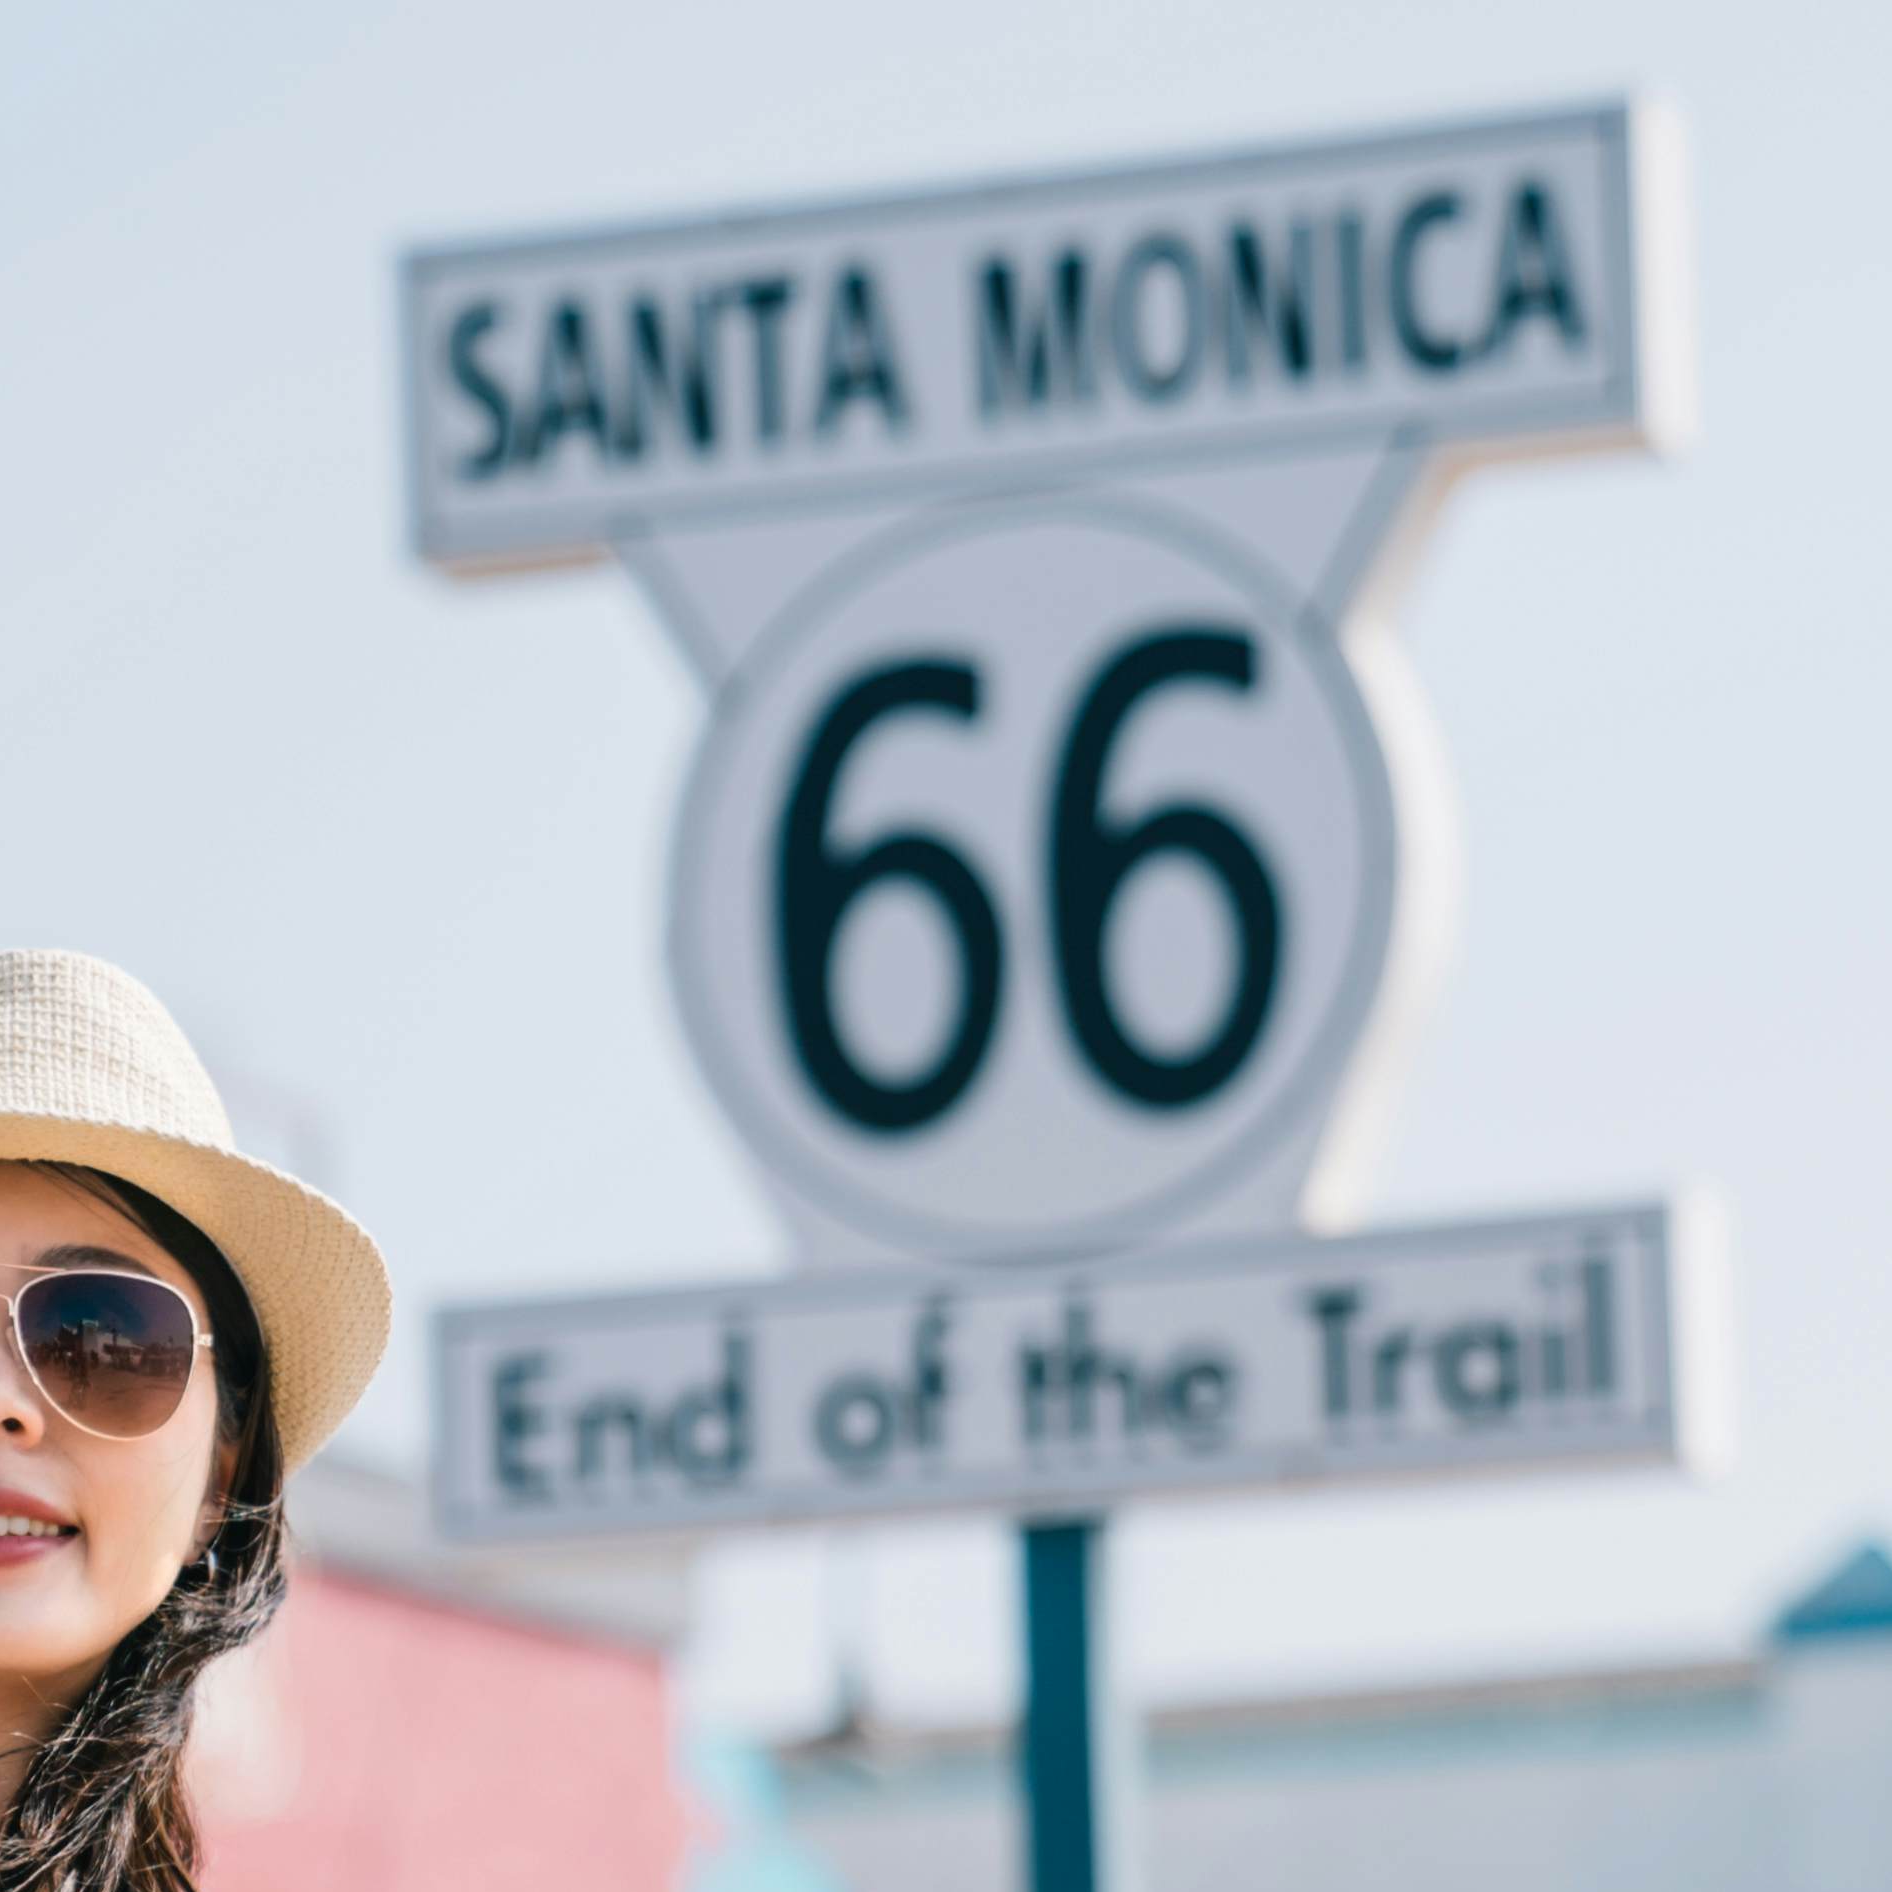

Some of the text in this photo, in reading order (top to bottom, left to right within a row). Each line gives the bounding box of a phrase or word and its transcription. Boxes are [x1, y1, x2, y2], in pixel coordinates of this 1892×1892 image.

[442, 171, 1591, 485] SANTA MONICA
[769, 622, 1287, 1142] 66
[485, 1243, 1622, 1510] End of the Trail
